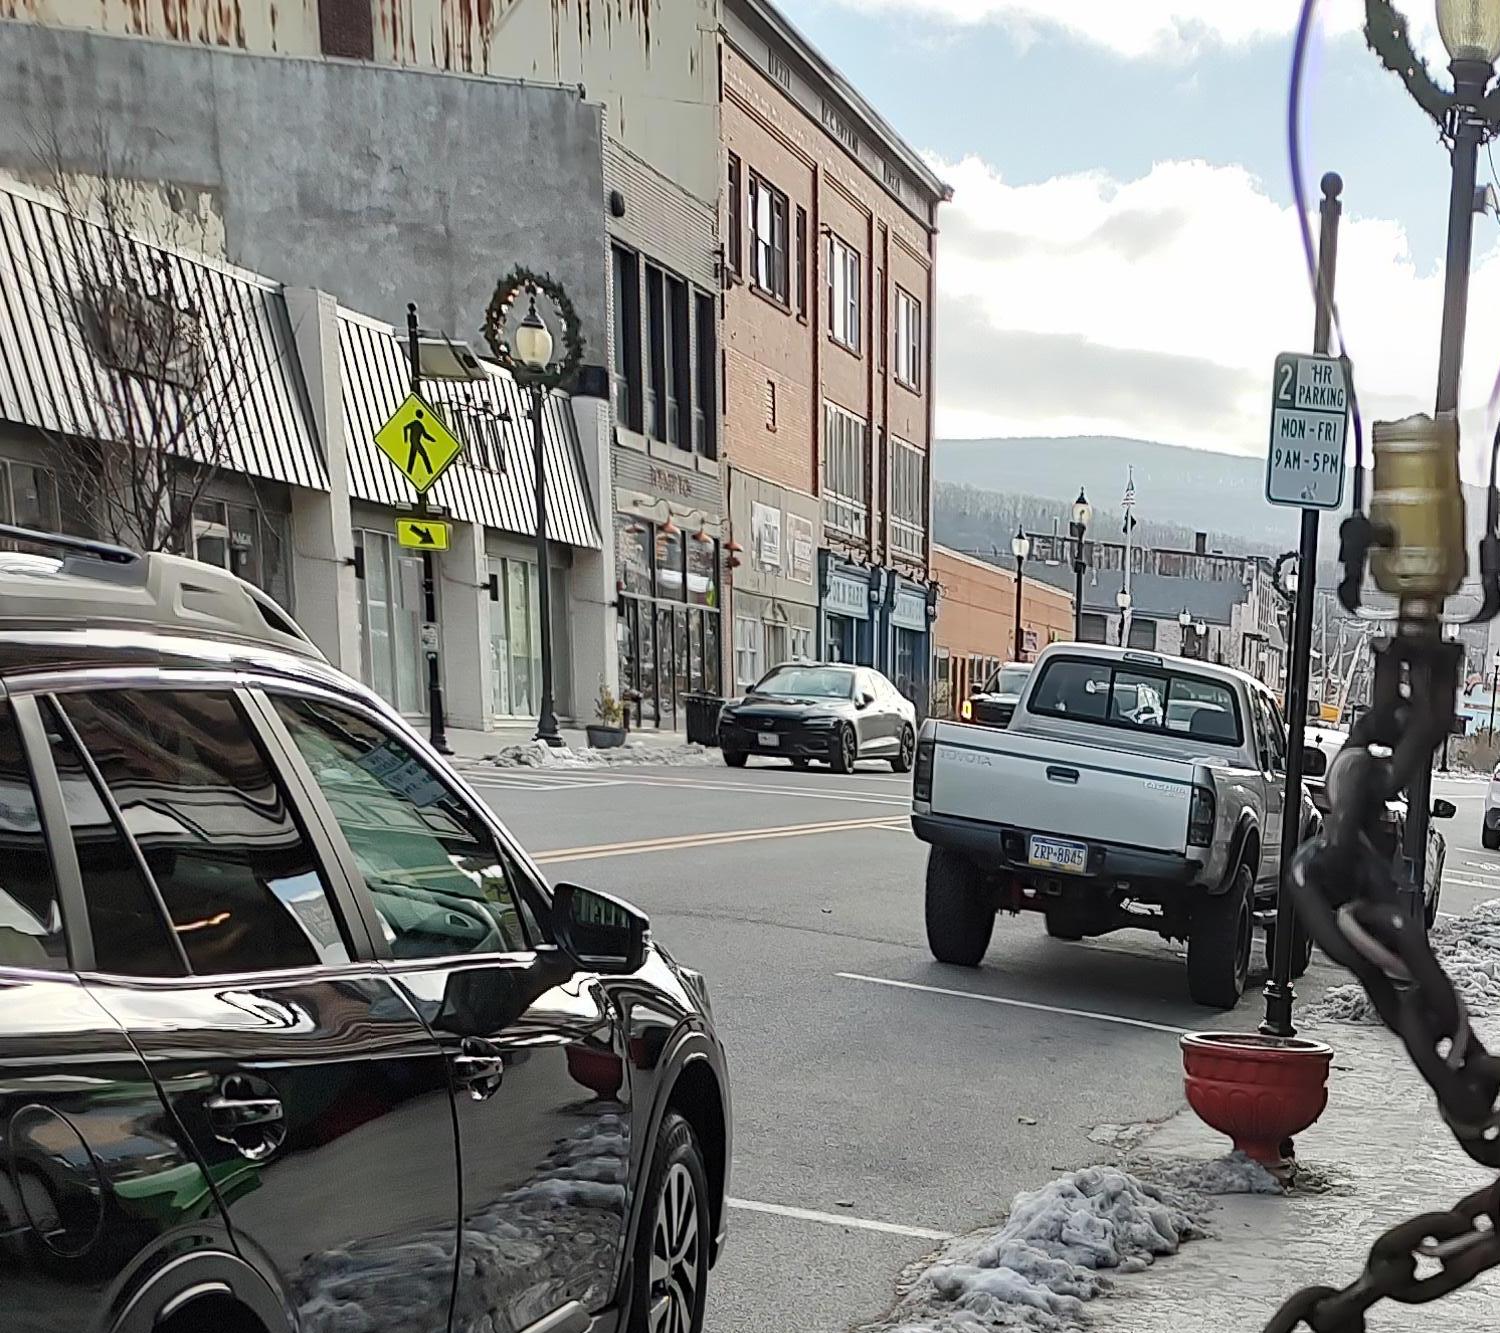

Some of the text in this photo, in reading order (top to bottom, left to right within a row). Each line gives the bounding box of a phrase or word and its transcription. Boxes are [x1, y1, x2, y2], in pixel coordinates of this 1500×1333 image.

[1279, 364, 1333, 400] 2 HR
[1299, 385, 1344, 407] PARKING
[939, 748, 992, 767] TOYOTA
